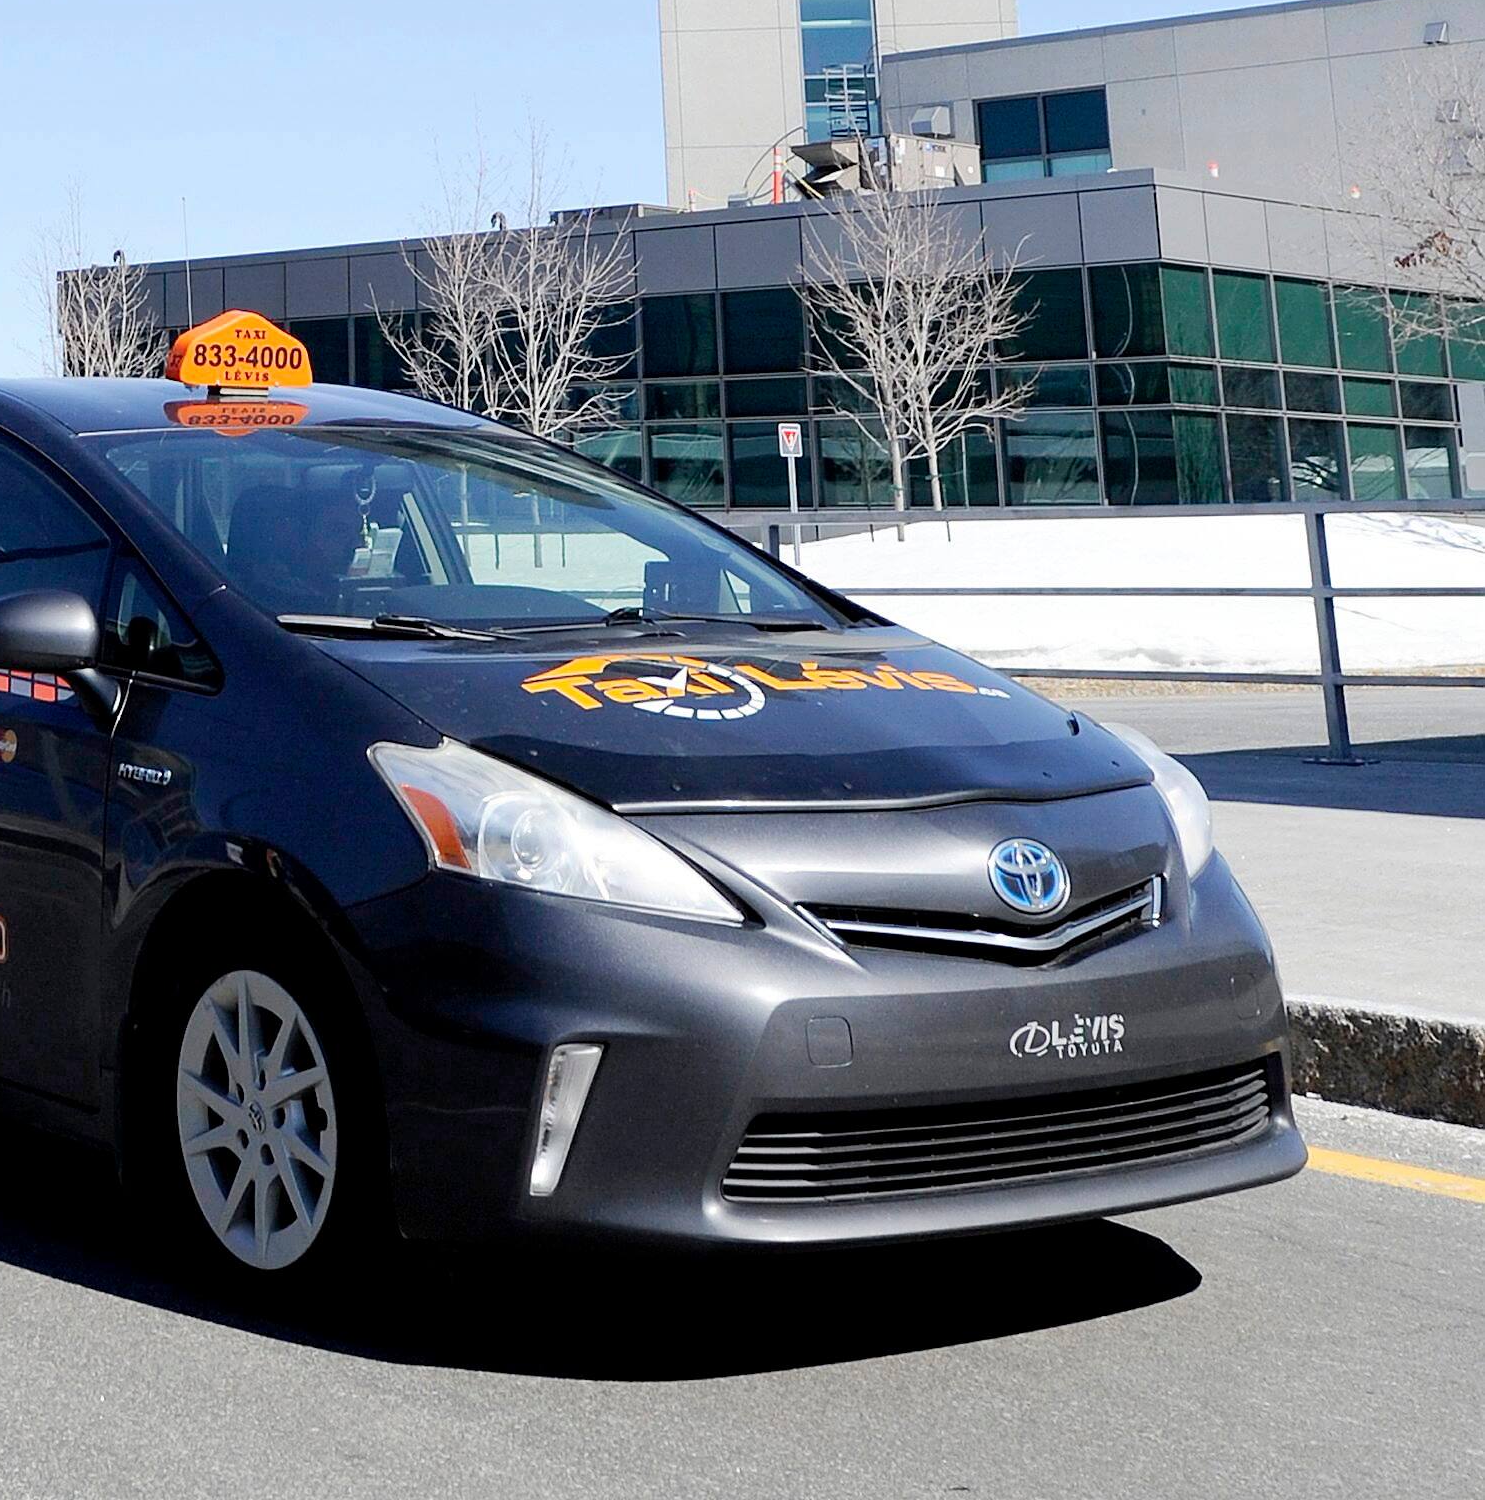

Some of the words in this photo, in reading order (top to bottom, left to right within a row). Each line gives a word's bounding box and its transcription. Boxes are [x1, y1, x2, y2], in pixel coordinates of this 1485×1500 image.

[235, 329, 266, 340] TAXI
[193, 344, 302, 370] 833-4000
[225, 369, 269, 382] LÉVIS
[521, 666, 735, 711] Taxi
